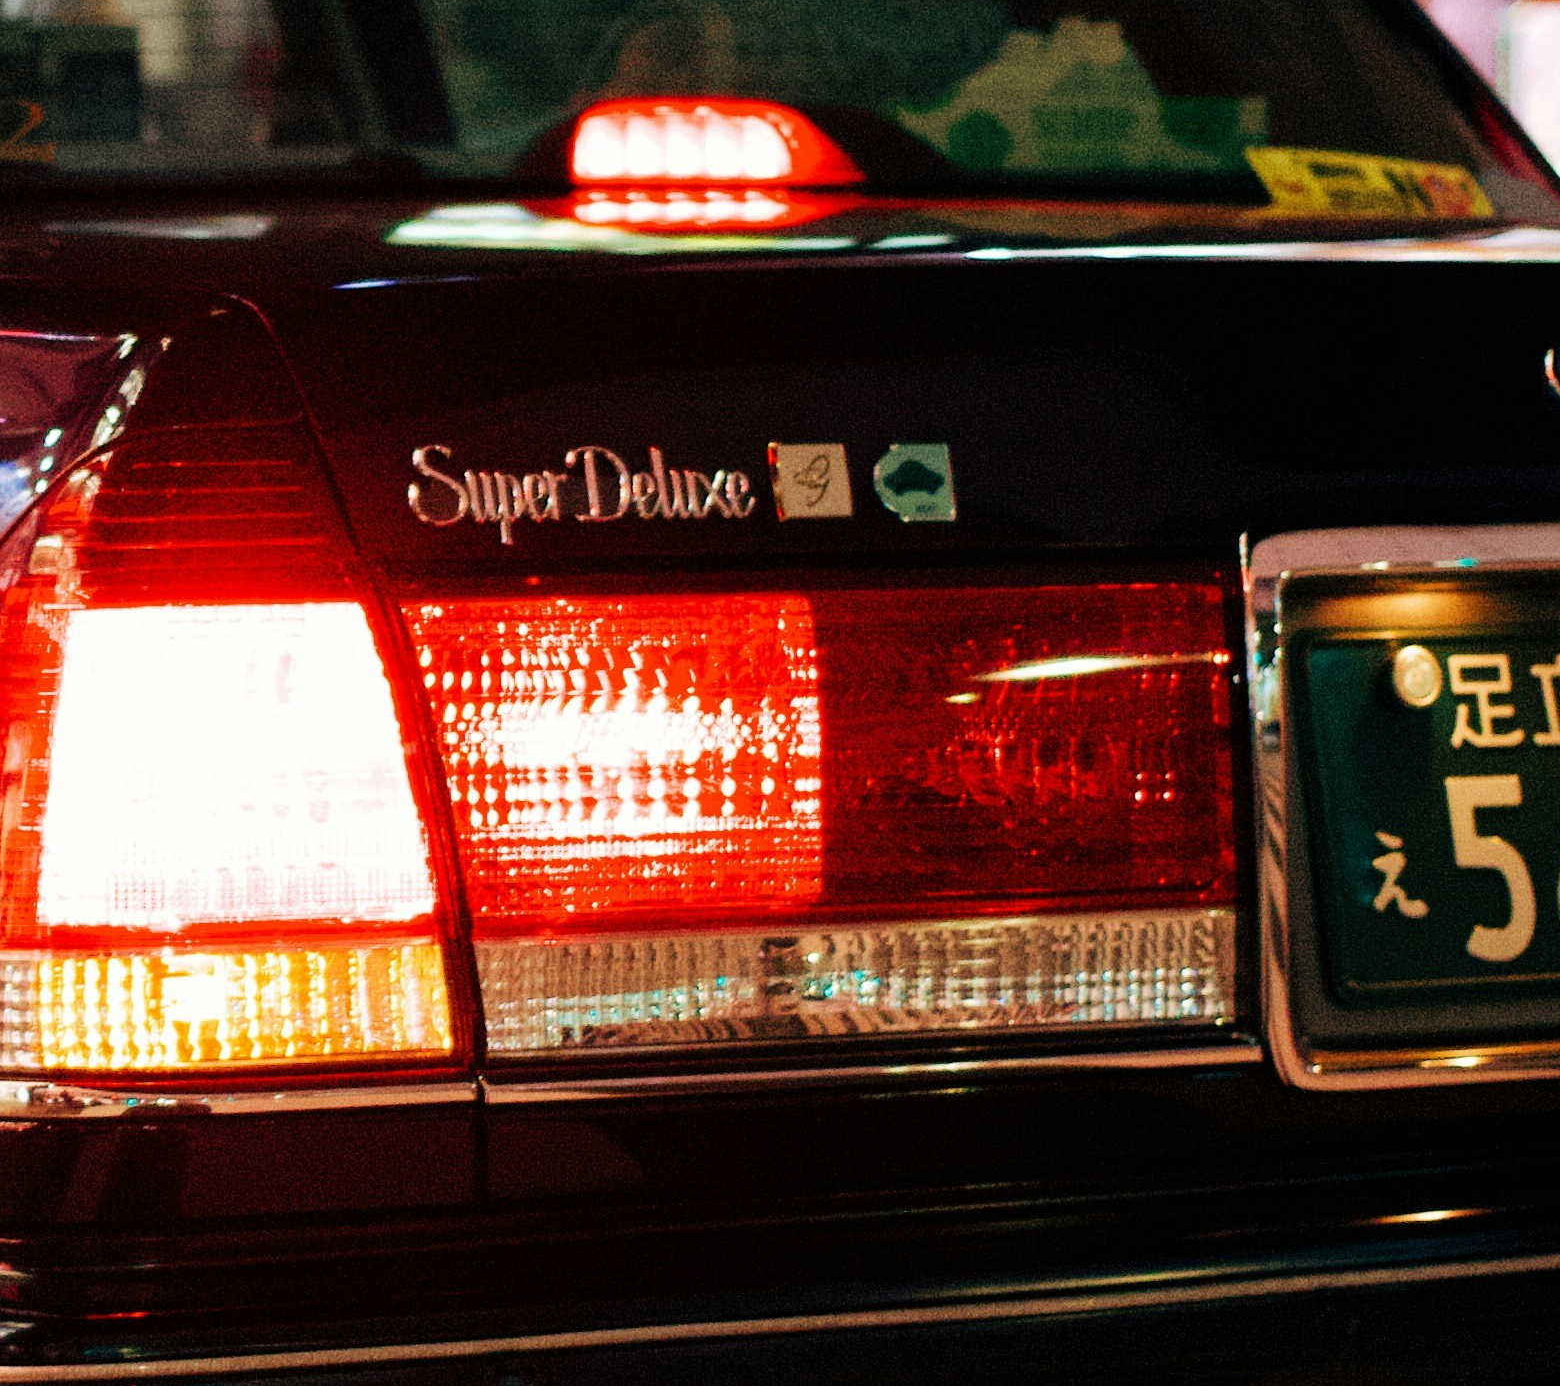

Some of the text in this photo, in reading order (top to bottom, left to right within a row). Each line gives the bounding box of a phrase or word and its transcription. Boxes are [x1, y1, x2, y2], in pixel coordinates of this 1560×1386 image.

[408, 444, 757, 545] Super Deluxe
[1370, 830, 1431, 920] え
